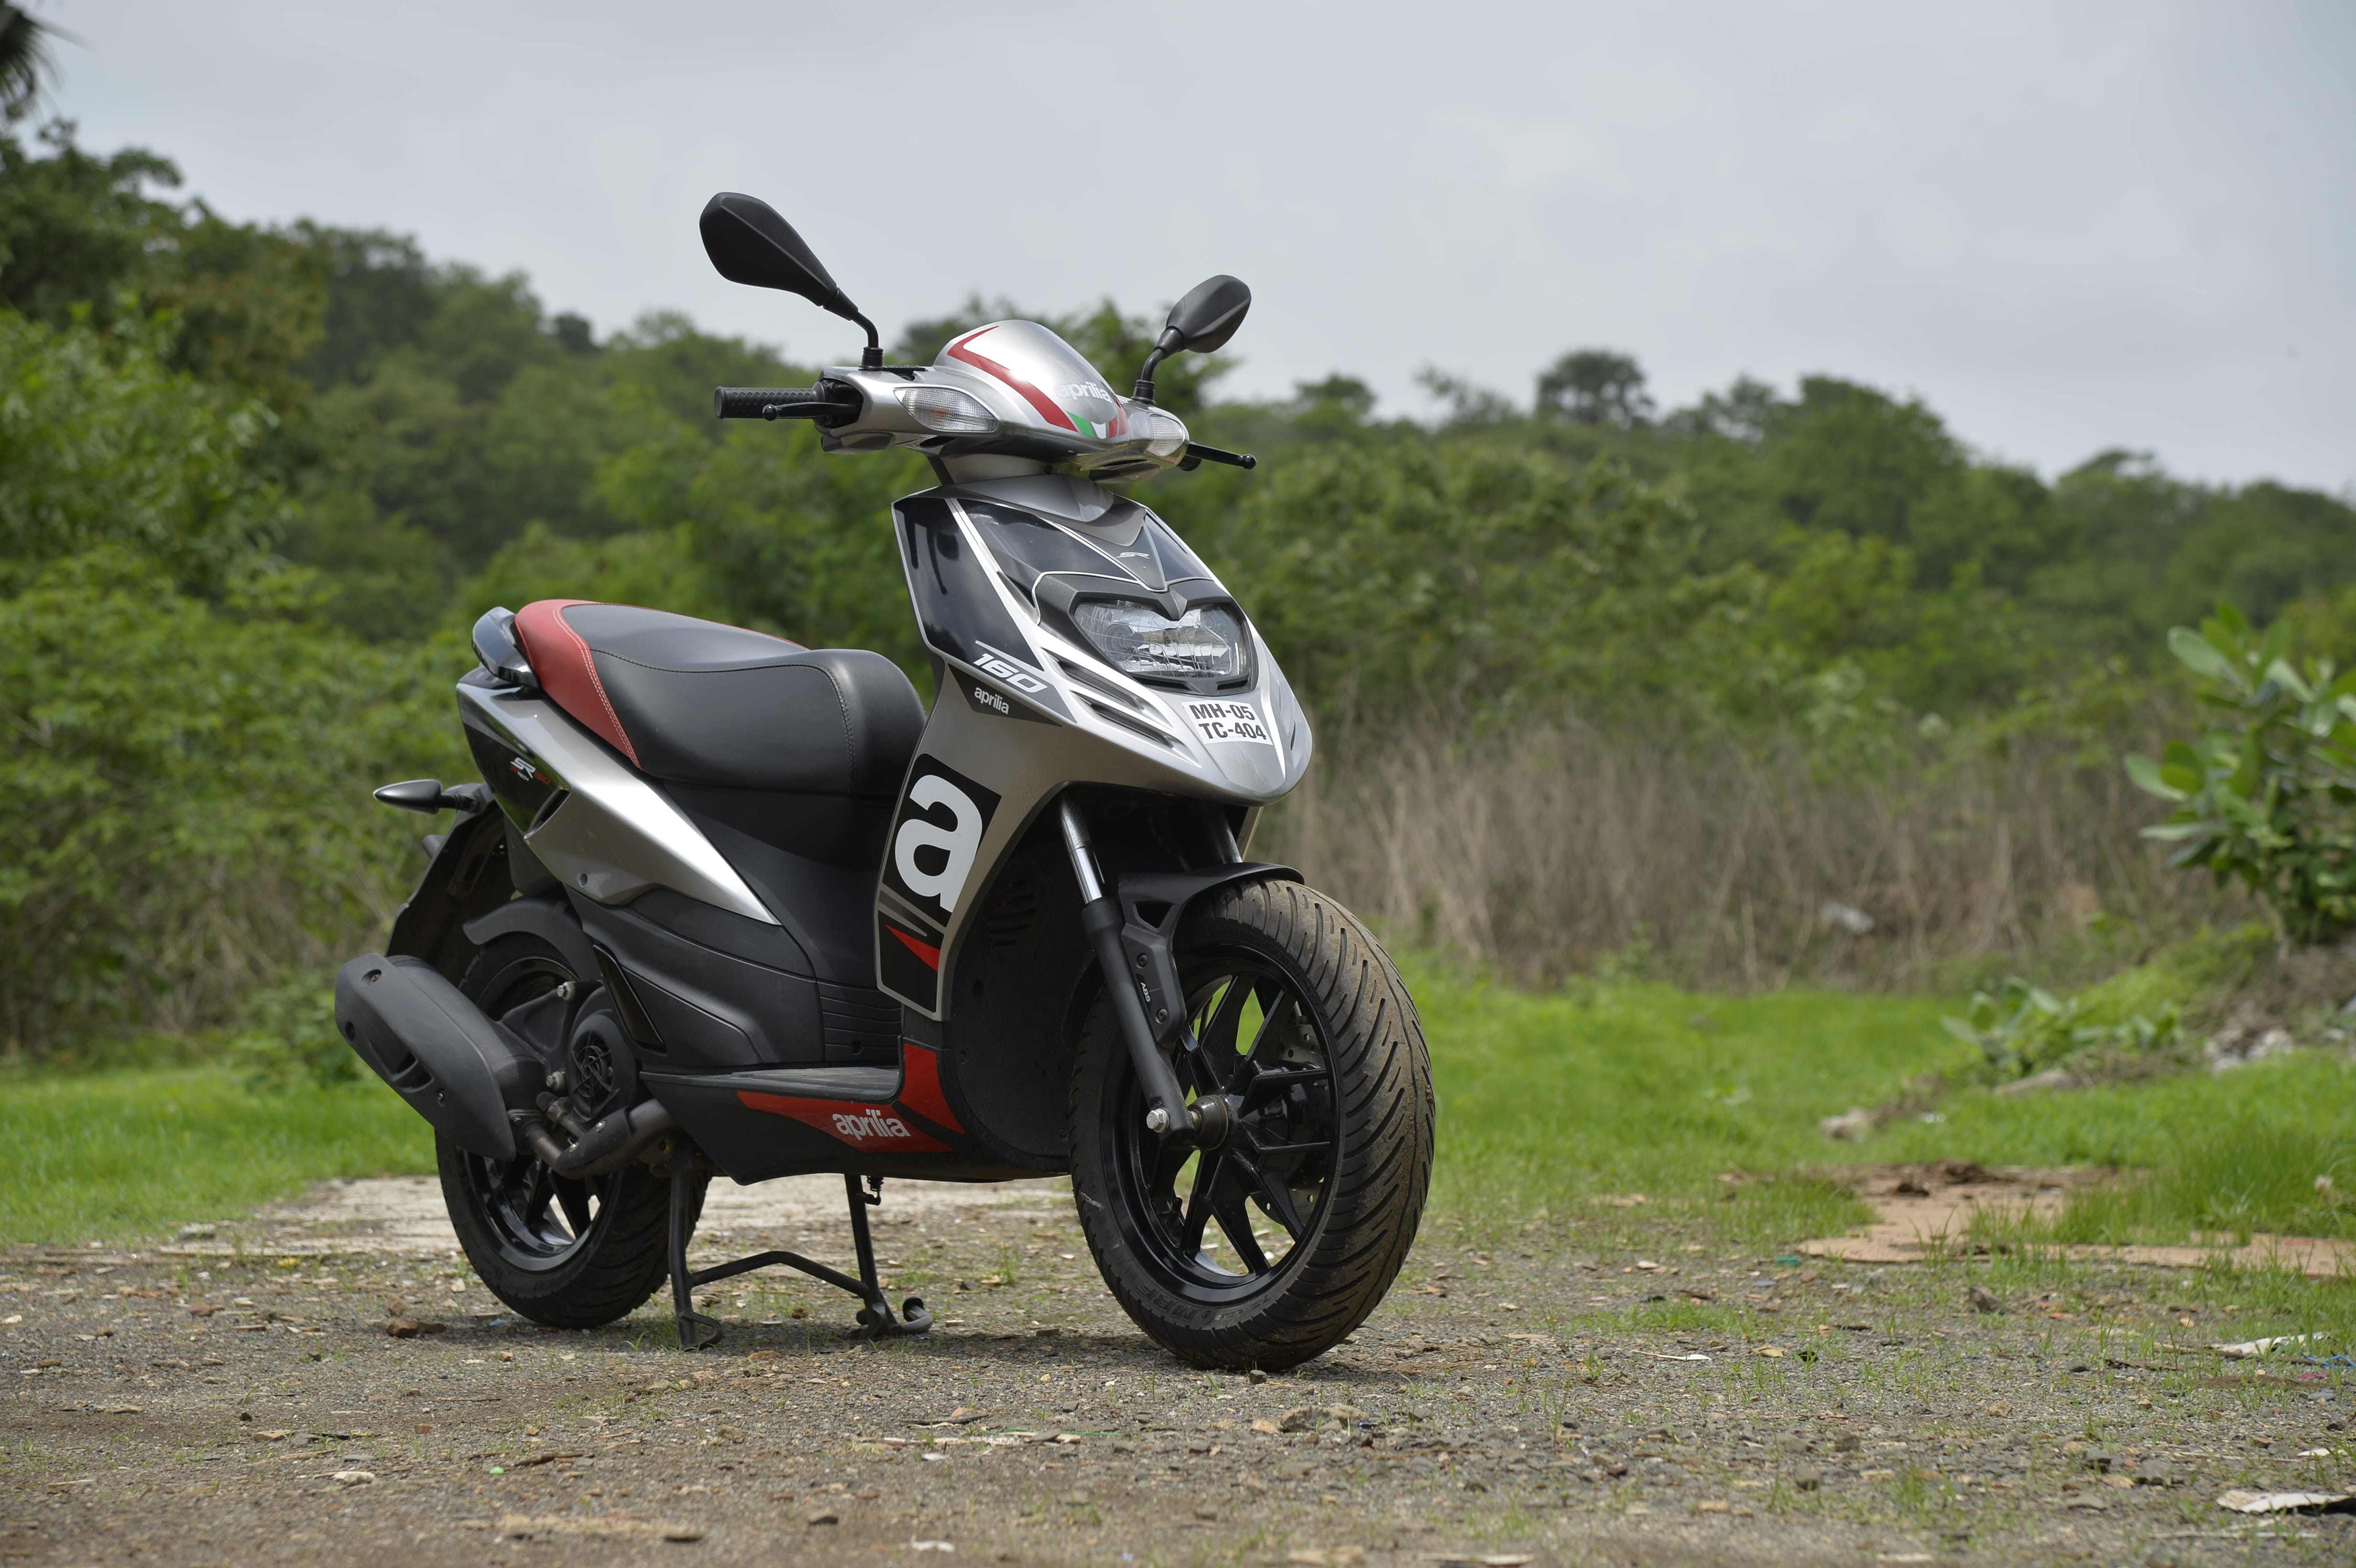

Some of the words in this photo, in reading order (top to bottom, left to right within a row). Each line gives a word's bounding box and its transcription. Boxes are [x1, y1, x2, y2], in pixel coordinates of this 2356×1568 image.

[1053, 381, 1113, 404] aprilia
[973, 653, 1048, 693] 160
[974, 687, 1009, 715] aprilia
[1189, 703, 1255, 720] MH-05
[1198, 722, 1267, 740] TC-404
[895, 774, 983, 913] a
[1140, 982, 1151, 1002] ABS
[832, 1109, 911, 1140] aprilia
[1136, 1284, 1199, 1322] MRF
